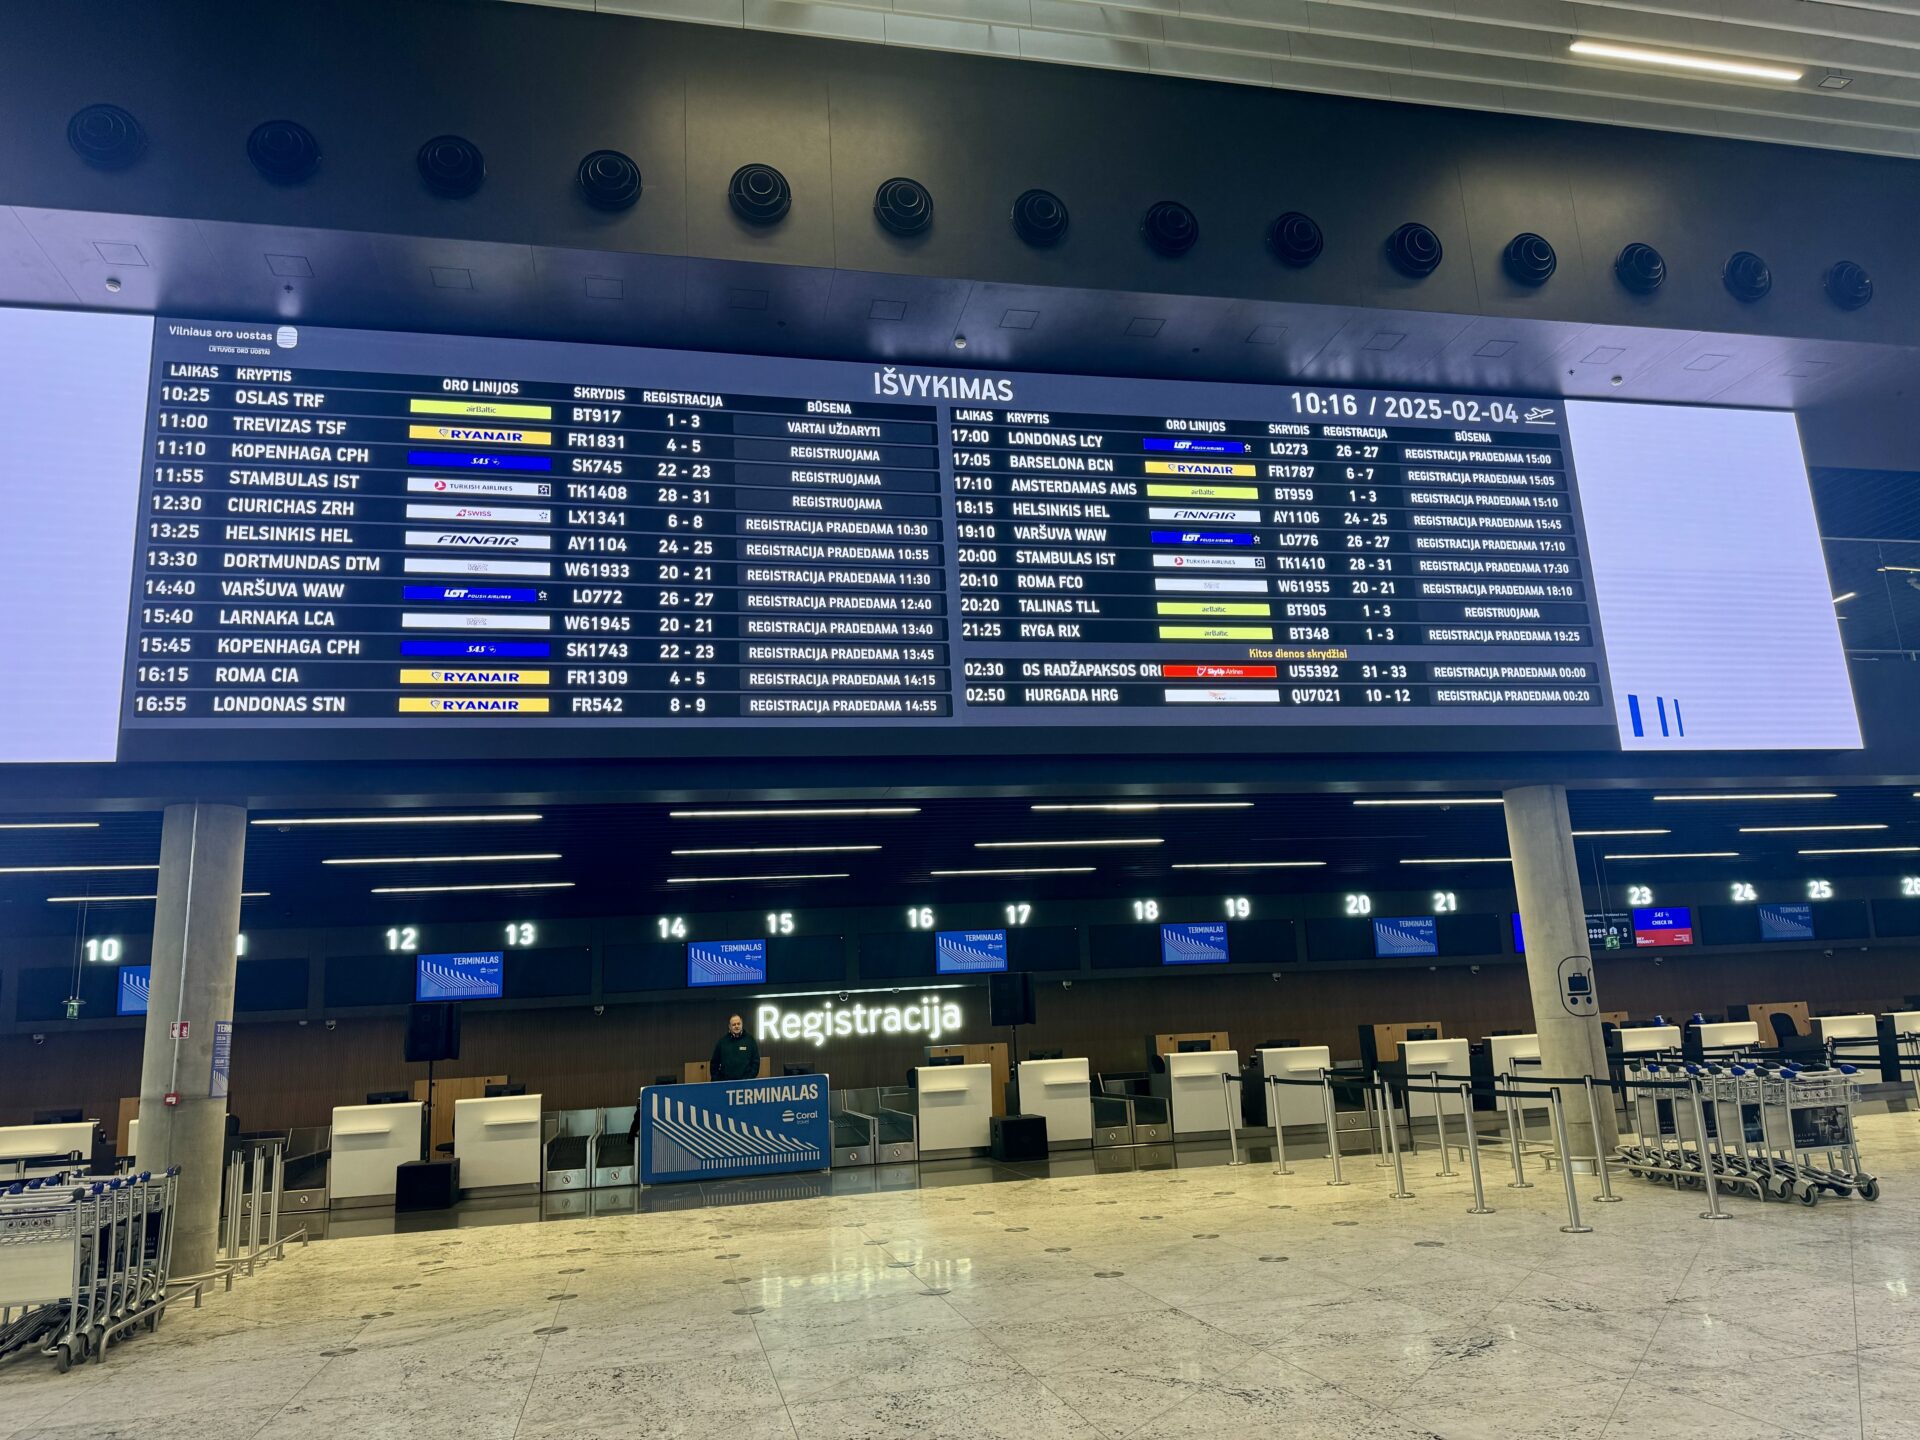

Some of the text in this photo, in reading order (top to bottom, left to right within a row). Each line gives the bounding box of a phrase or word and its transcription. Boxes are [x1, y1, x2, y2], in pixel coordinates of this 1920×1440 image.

[169, 325, 272, 341] Vilniaus oro uostas
[236, 346, 249, 355] ORO
[171, 364, 852, 414] LAIKAS KRYPTIS ORO LINIJOS SKRYDIS REGISTRACIJA BŪSENA
[874, 367, 1013, 401] IŠVYKIMAS
[162, 386, 880, 437] 10:25 OSLAS TRF BT917 VARTAI UŽDARYTI
[1292, 392, 1357, 415] 10:16
[1384, 397, 1519, 423] 2025-02-04
[956, 410, 1492, 443] LAIKAS KRYPTIS ORO LINIJOS SKRYDIS REGISTRACIJA BŪSENA
[160, 413, 880, 462] 11:00 TREVIZAS TSF RYANAIR FR1831 REGISTRUOJAMA
[952, 429, 989, 443] 17:00
[1008, 432, 1077, 447] LONDONAS
[1080, 435, 1103, 448] LCY
[158, 440, 622, 474] 11:10 KOPENHAGA CPH SK745
[953, 453, 1314, 478] 17:05 BARSELONA BCN FR1787
[155, 468, 627, 500] 11:55 STAMBULAS IST TK1408
[954, 476, 1313, 501] 17:10 AMSTERDAMAS AMS BT959
[153, 495, 624, 526] 12:30 CIURICHAS ZRH SWISS LX1341
[956, 500, 1320, 523] 18:15 HELSINKIS HEL AY1106
[151, 523, 627, 552] 13:25 HELSINKIS HEL FINNAIR AY1104
[957, 525, 995, 538] 19:10
[1014, 524, 1072, 540] VARŠUVA
[1075, 528, 1107, 541] WAW
[148, 551, 629, 578] 13:30 DORTMUNDAS DTM W61933
[958, 549, 1325, 570] 20:00 STAMBULAS IST TK1410
[146, 580, 195, 595] 14:40
[222, 578, 298, 597] VARŠUVA
[303, 583, 345, 598] WAW
[443, 588, 468, 599] LOT
[960, 573, 1330, 593] 20:10 ROMA FCO W61955
[961, 598, 1327, 616] 20:20 TALINAS TLL BT905
[143, 608, 630, 631] 15:40 LARNAKA LCA W61945
[962, 623, 1329, 640] 21:25 RYGA RIX BT348
[141, 637, 628, 657] 15:45 KOPENHAGA CPH SK1743
[1248, 647, 1348, 660] Kitos dienos skrydžiai
[138, 667, 628, 684] 16:15 ROMA CIA FR1309
[964, 663, 1004, 676] 02:30
[1044, 661, 1137, 677] RADŽAPAKSOS
[1289, 665, 1339, 678] U55392
[136, 696, 622, 712] 16:55 LONDONAS STN FR542
[966, 688, 1340, 704] 02:50 HURGADA HRG QU7021
[1628, 886, 1653, 906] 23
[1731, 882, 1757, 902] 24
[1807, 880, 1833, 900] 25
[1134, 899, 1160, 921] 18
[1225, 897, 1250, 919] 19
[1346, 893, 1371, 915] 20
[1434, 892, 1457, 913] 21
[767, 913, 795, 934] 15
[908, 908, 935, 929] 16
[1006, 903, 1031, 925] 17
[1398, 919, 1433, 930] TERMINALAS
[506, 923, 536, 946] 13
[658, 917, 687, 939] 14
[964, 933, 1003, 943] TERMINALAS
[1187, 924, 1224, 935] TERMINALAS
[386, 927, 418, 952] 12
[720, 943, 763, 954] TERMINALAS
[85, 938, 121, 963] 10
[452, 955, 499, 967] TERMINALAS
[756, 997, 962, 1047] Registracija
[725, 1082, 819, 1107] TERMINALAS
[795, 1109, 819, 1121] Coral
